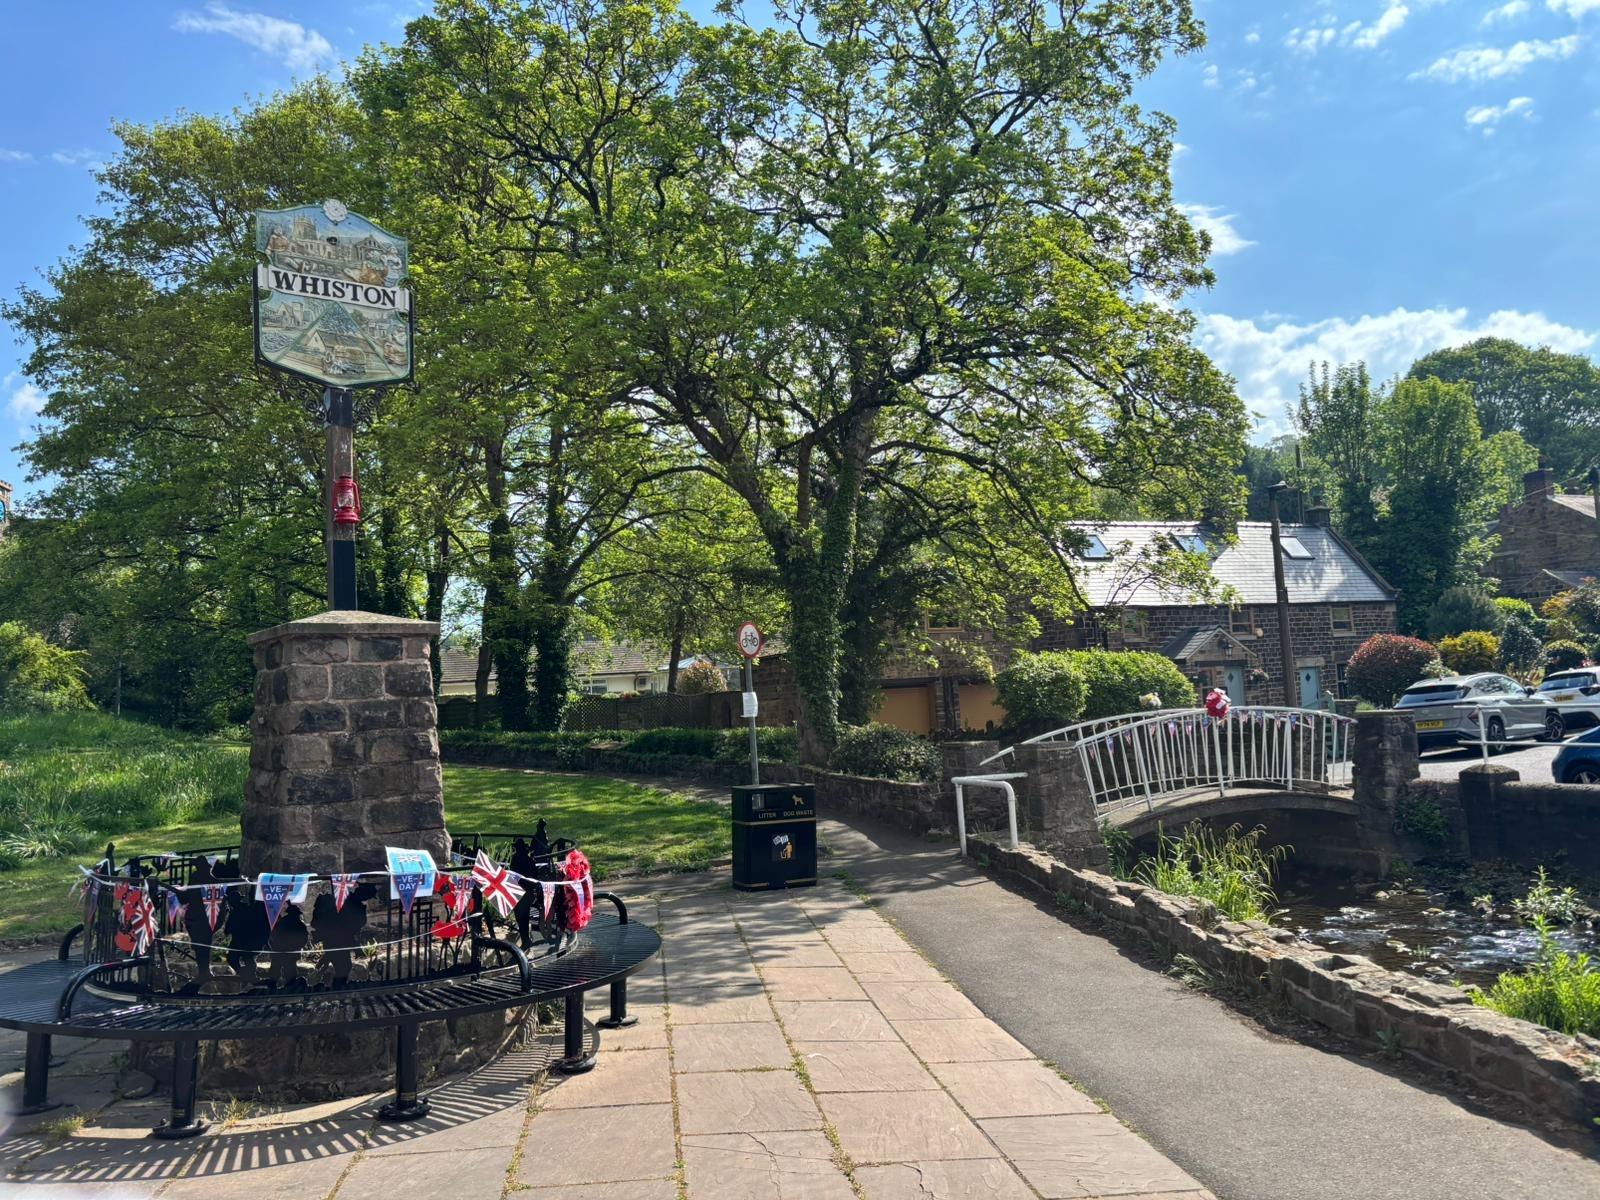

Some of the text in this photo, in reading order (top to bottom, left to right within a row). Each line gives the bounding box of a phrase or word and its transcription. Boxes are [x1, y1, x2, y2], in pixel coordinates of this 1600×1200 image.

[272, 270, 397, 308] WHISTON
[401, 875, 413, 883] VE
[399, 882, 416, 891] DAY
[456, 878, 471, 890] 80
[269, 885, 283, 893] VE
[206, 888, 220, 900] 80
[265, 893, 284, 901] DAY
